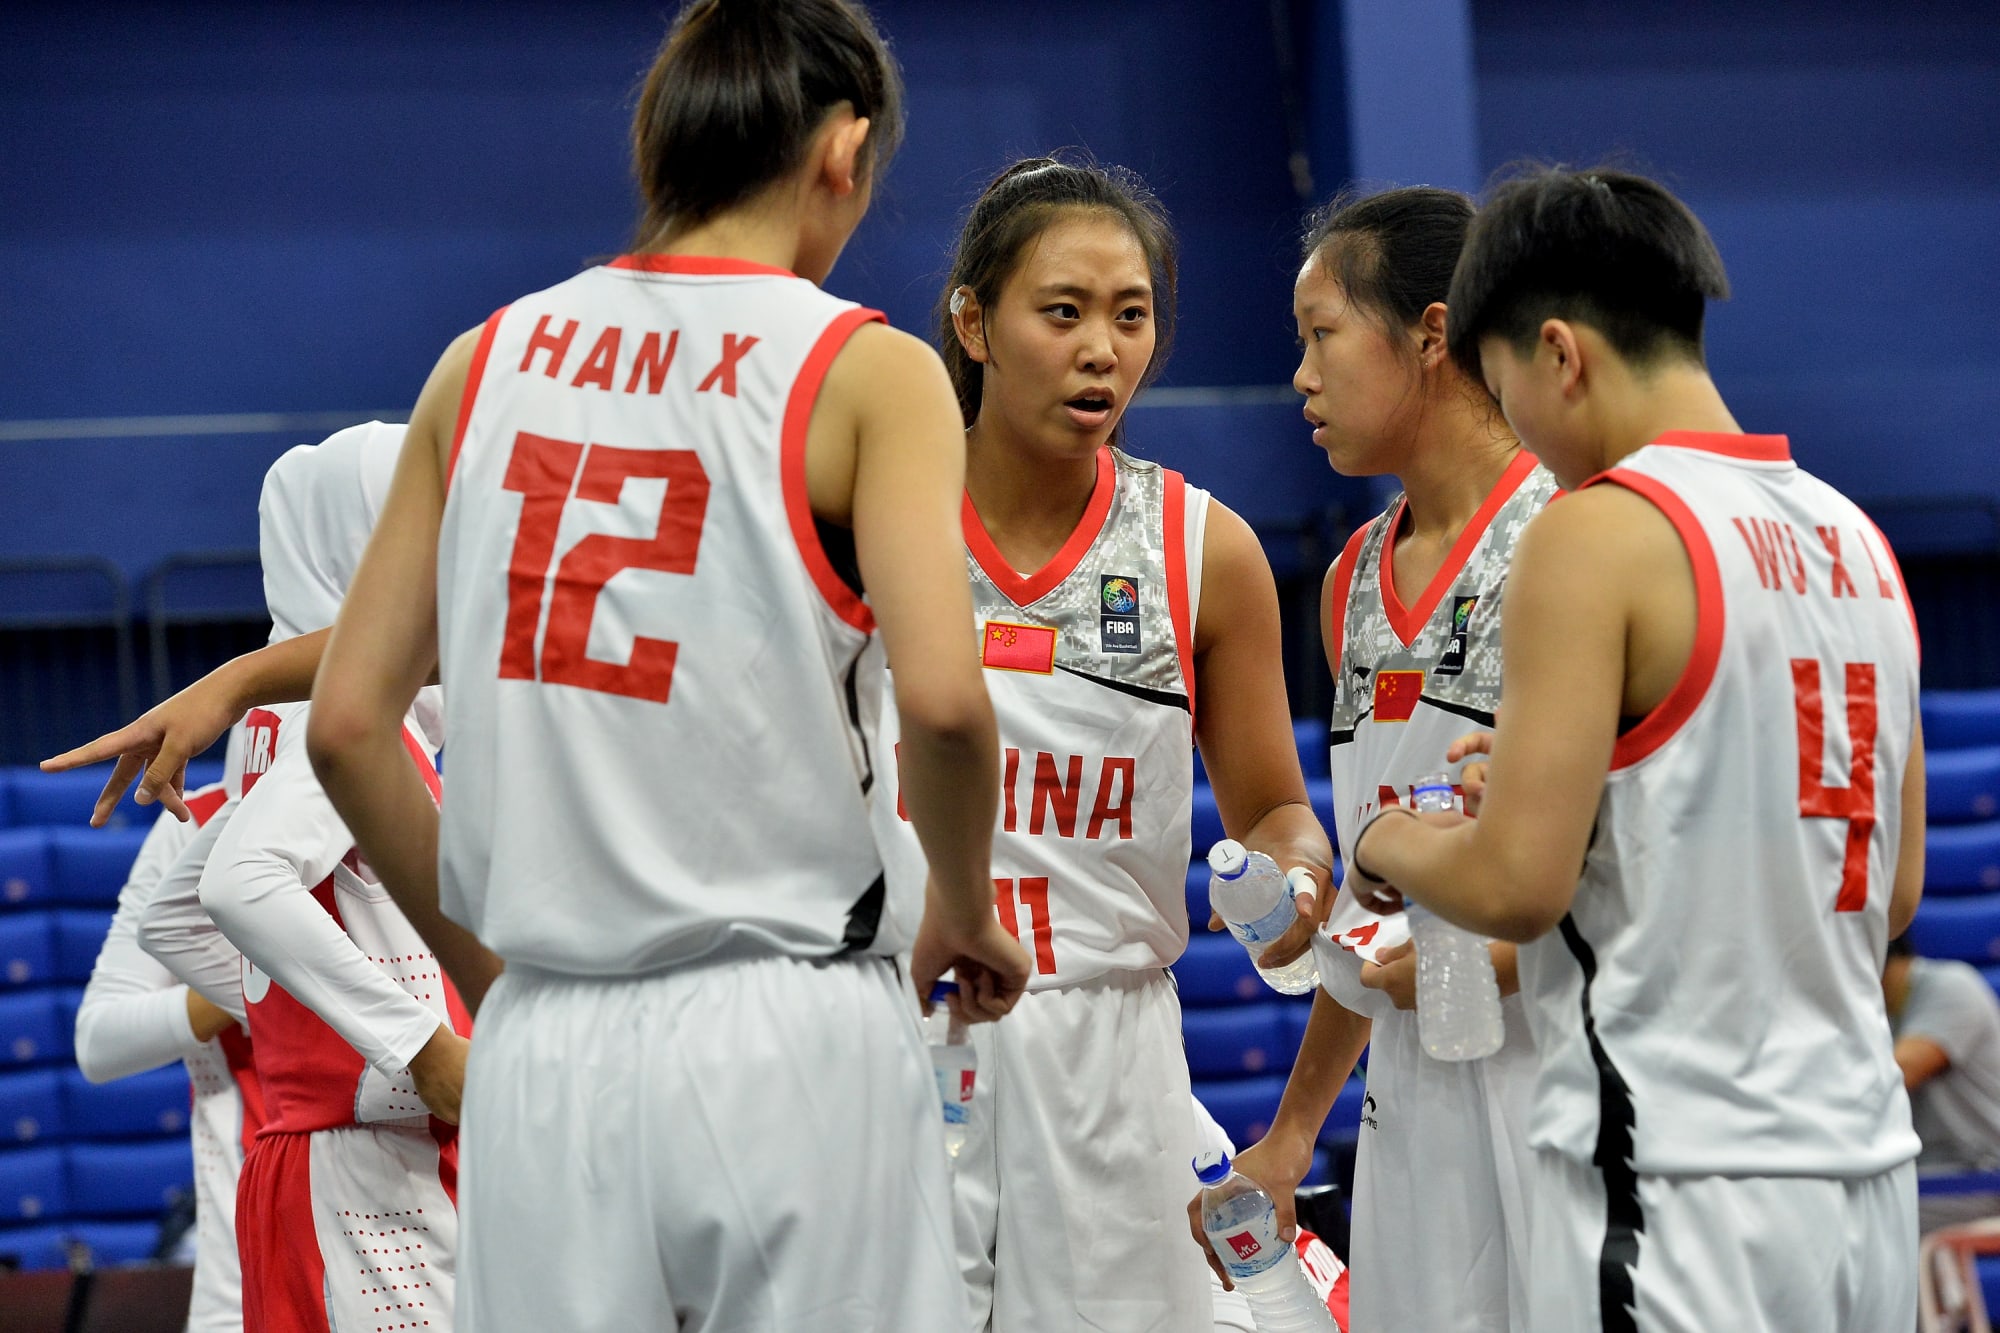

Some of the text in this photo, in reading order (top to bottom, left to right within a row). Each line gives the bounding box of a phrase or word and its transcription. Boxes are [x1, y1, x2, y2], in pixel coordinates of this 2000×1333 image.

[519, 314, 761, 398] HAN X
[497, 431, 712, 705] 12
[1731, 516, 1895, 600] WU X L
[1106, 620, 1134, 635] FIBA
[895, 741, 1136, 840] INA
[1789, 658, 1878, 913] 4
